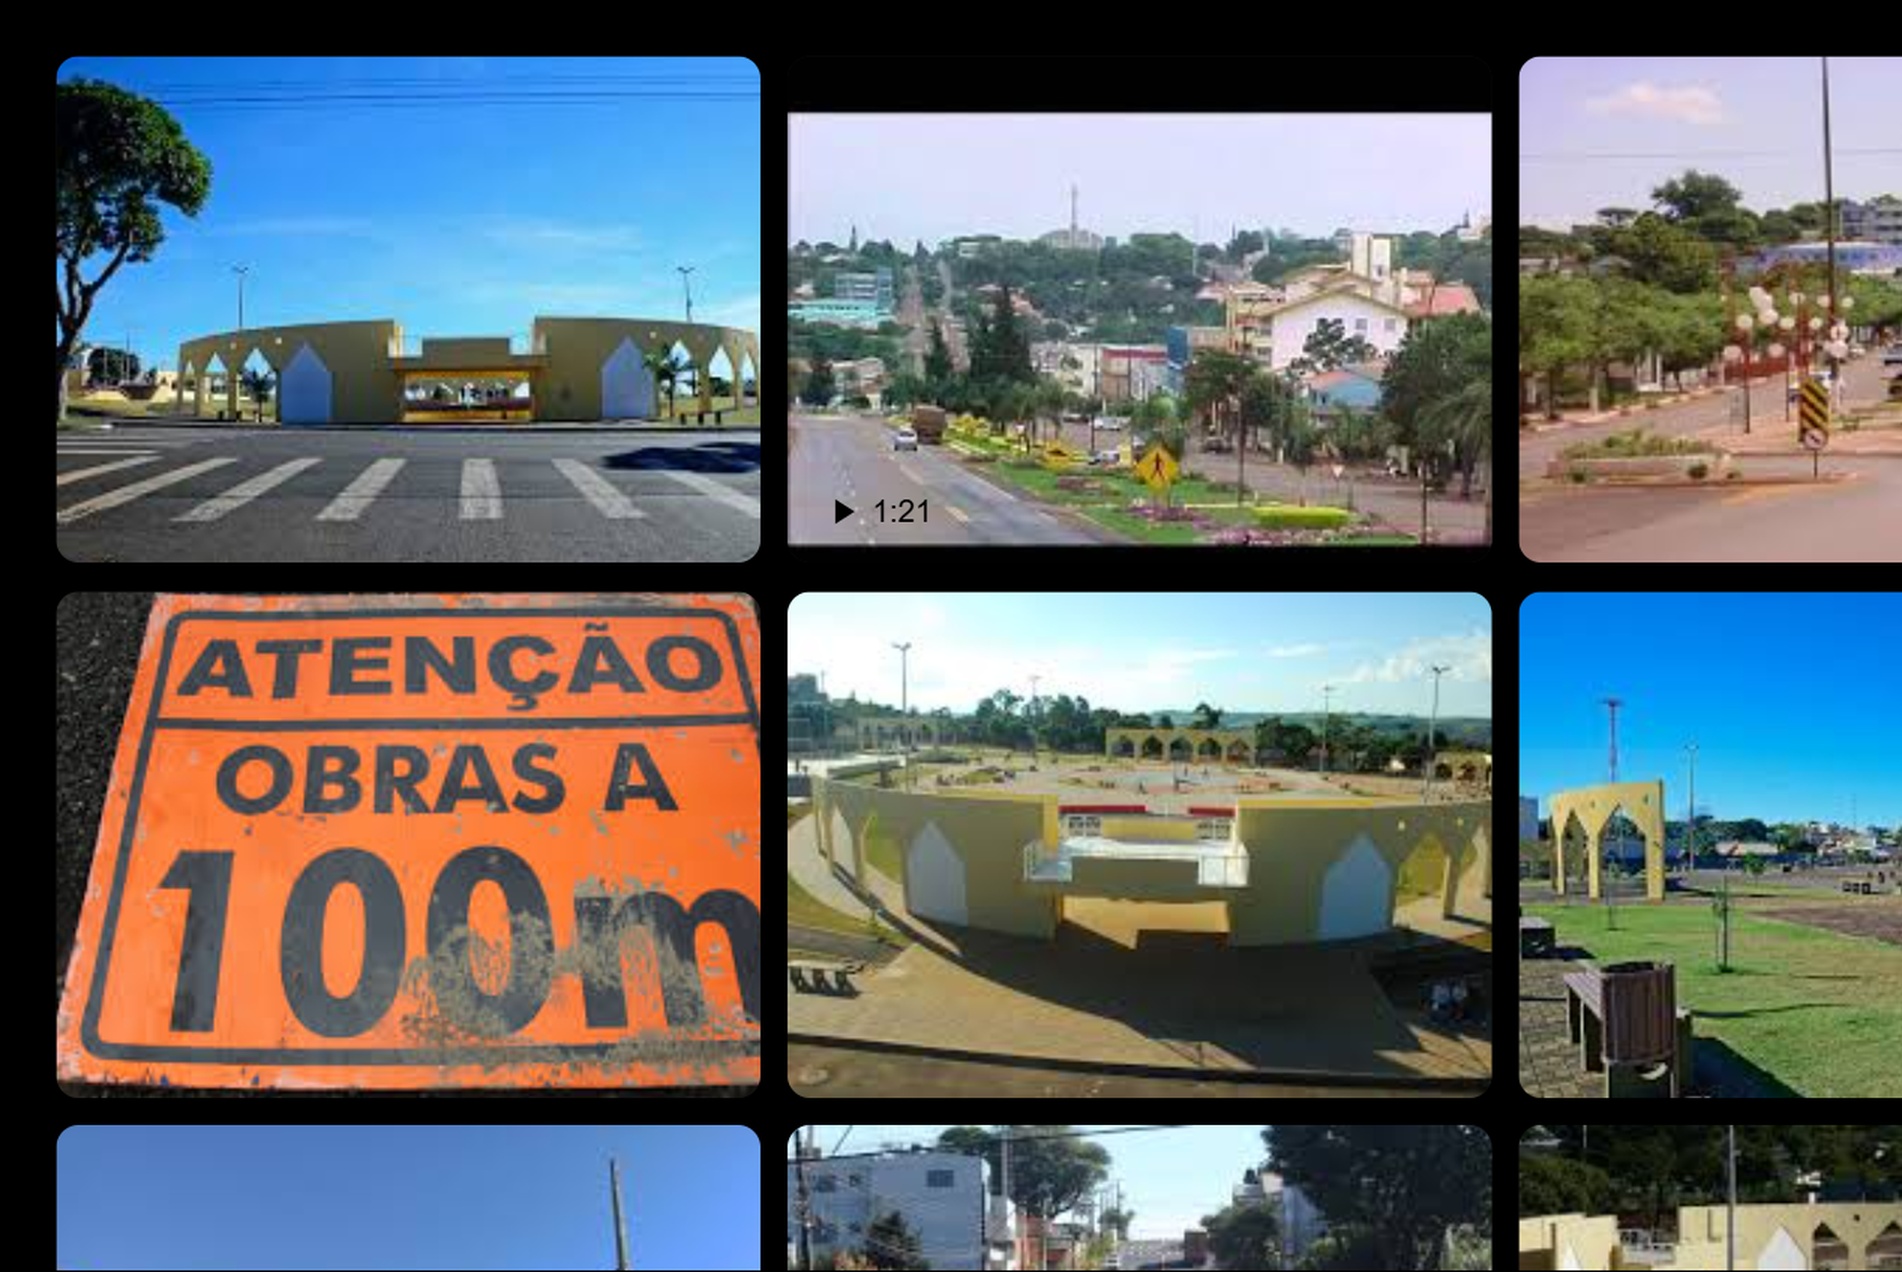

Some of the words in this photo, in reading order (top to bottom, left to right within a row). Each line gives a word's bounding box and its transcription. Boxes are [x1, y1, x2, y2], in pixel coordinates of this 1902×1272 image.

[176, 622, 723, 711] ATENÇÃO
[215, 743, 566, 816] OBRAS
[603, 742, 679, 812] A
[155, 845, 761, 1039] 100m
